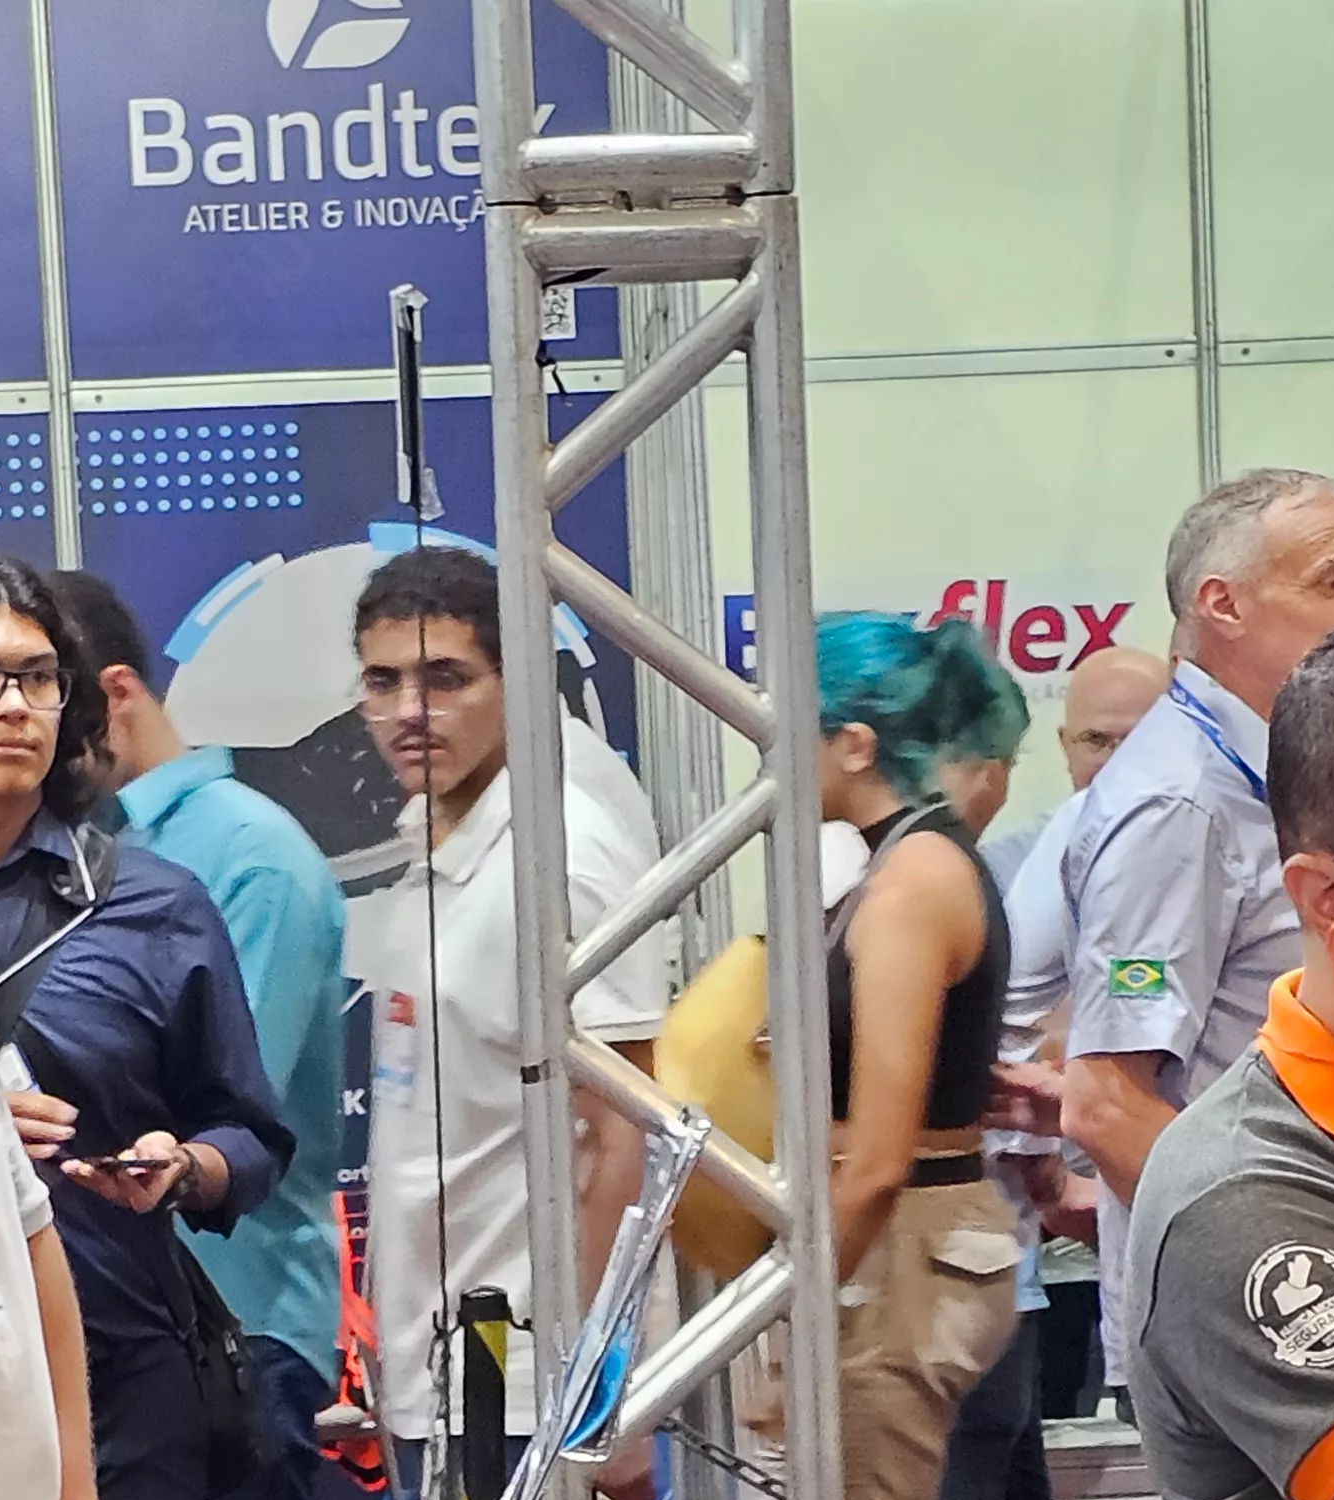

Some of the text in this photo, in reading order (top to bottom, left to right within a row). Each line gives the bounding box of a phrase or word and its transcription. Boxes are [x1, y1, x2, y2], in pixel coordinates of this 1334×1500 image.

[128, 82, 556, 187] Bandte
[183, 190, 486, 233] ATELIER & INOVAÇÃ
